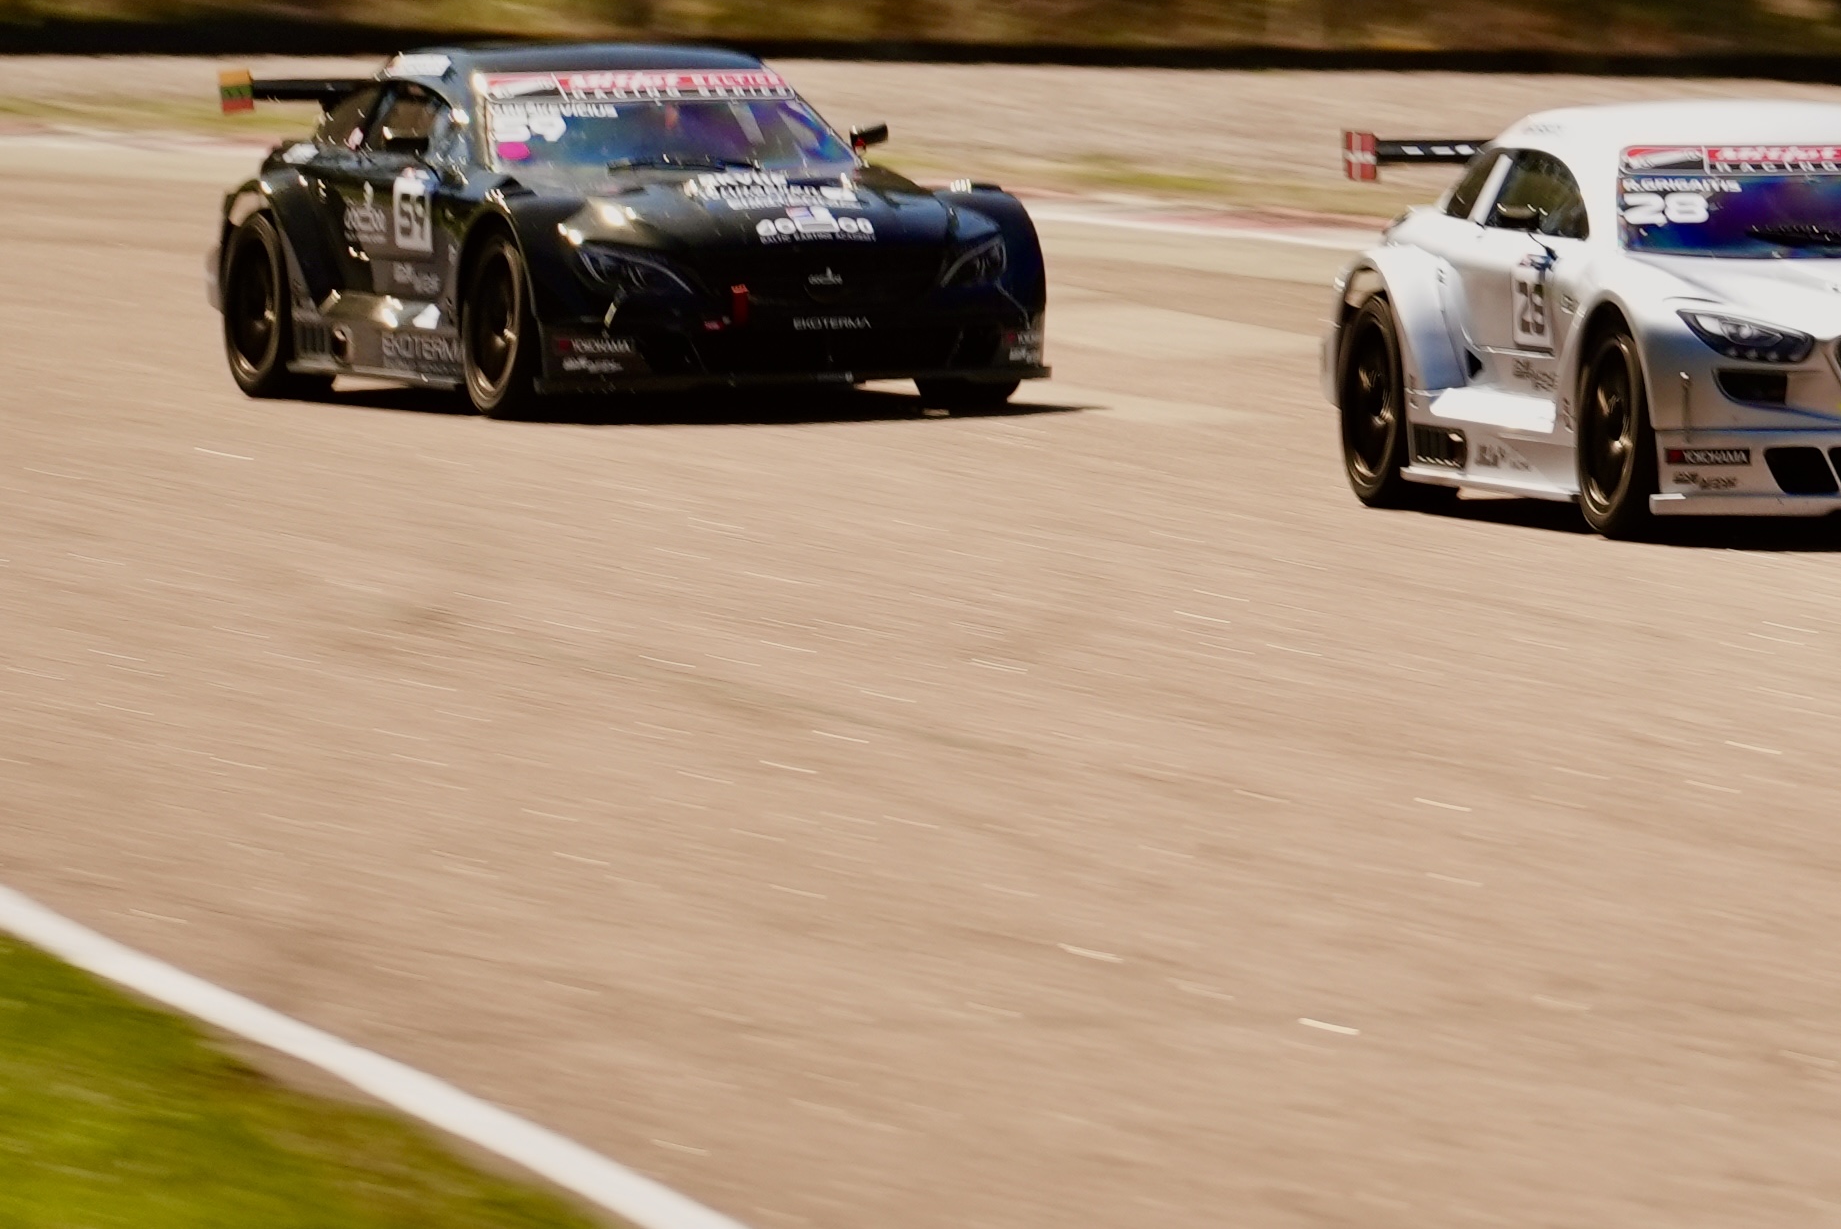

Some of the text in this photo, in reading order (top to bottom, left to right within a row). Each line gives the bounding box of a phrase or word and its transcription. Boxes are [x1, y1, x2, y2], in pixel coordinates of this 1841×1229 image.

[491, 113, 567, 142] 59
[1716, 161, 1840, 173] RACING
[400, 192, 426, 240] 59
[1623, 192, 1709, 226] 28
[793, 316, 873, 331] EKOTERMA
[1682, 450, 1749, 464] YOKOHAMA
